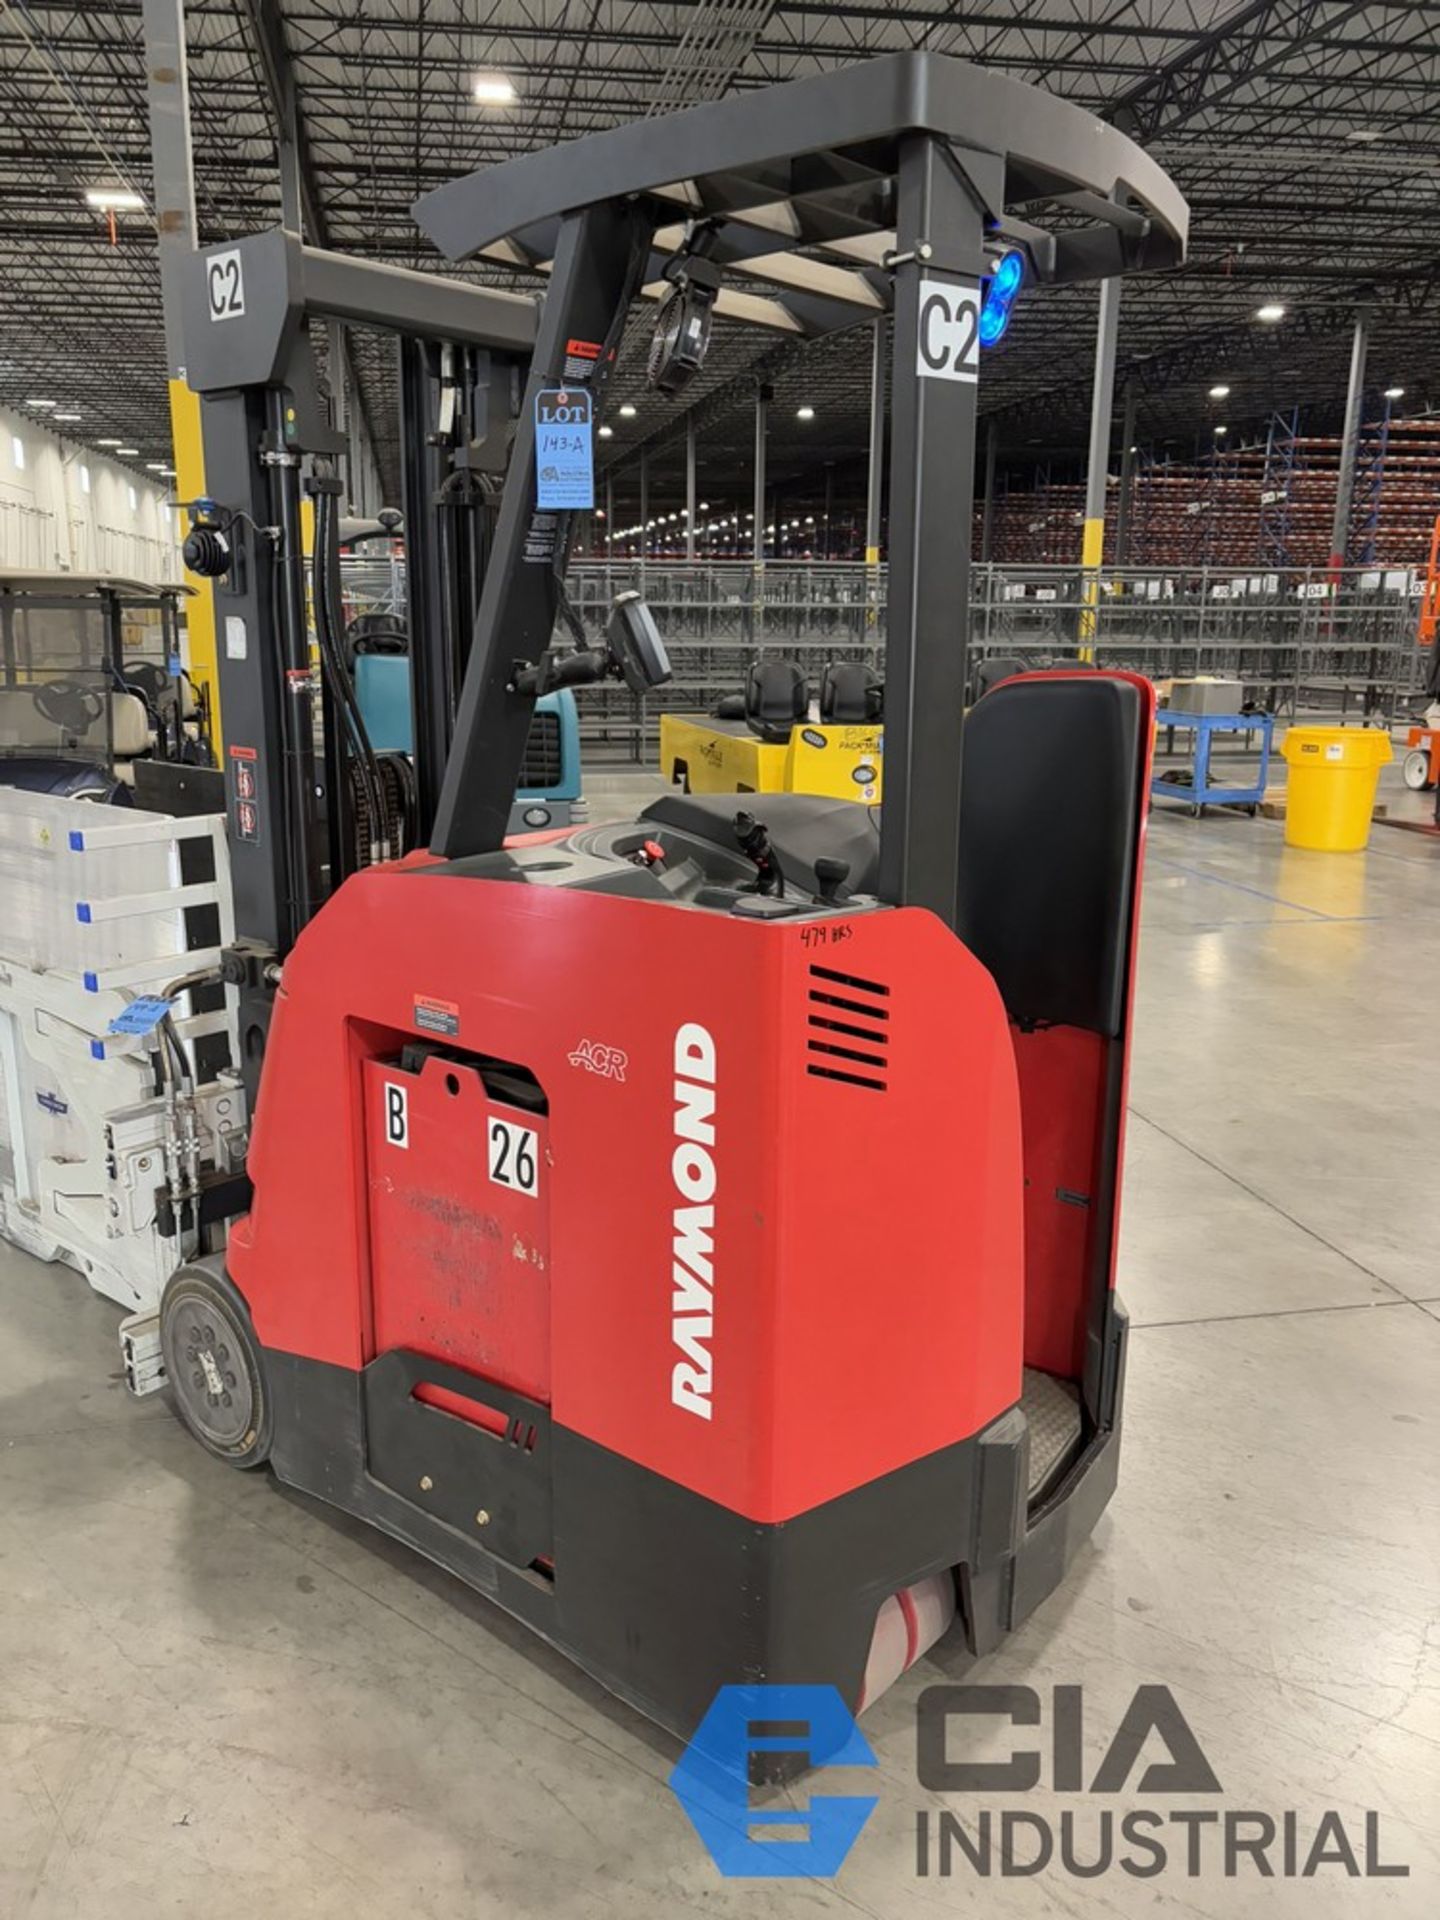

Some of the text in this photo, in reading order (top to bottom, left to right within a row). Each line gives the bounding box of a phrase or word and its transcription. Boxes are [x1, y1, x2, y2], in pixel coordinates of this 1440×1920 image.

[208, 258, 242, 316] C2
[919, 293, 978, 375] C2
[541, 405, 585, 423] LOT
[542, 434, 585, 456] 143-A
[800, 926, 826, 948] 479
[568, 1038, 628, 1082] ACR
[387, 1086, 405, 1141] B
[491, 1122, 535, 1189] 26
[671, 1022, 718, 1421] RAYMOND
